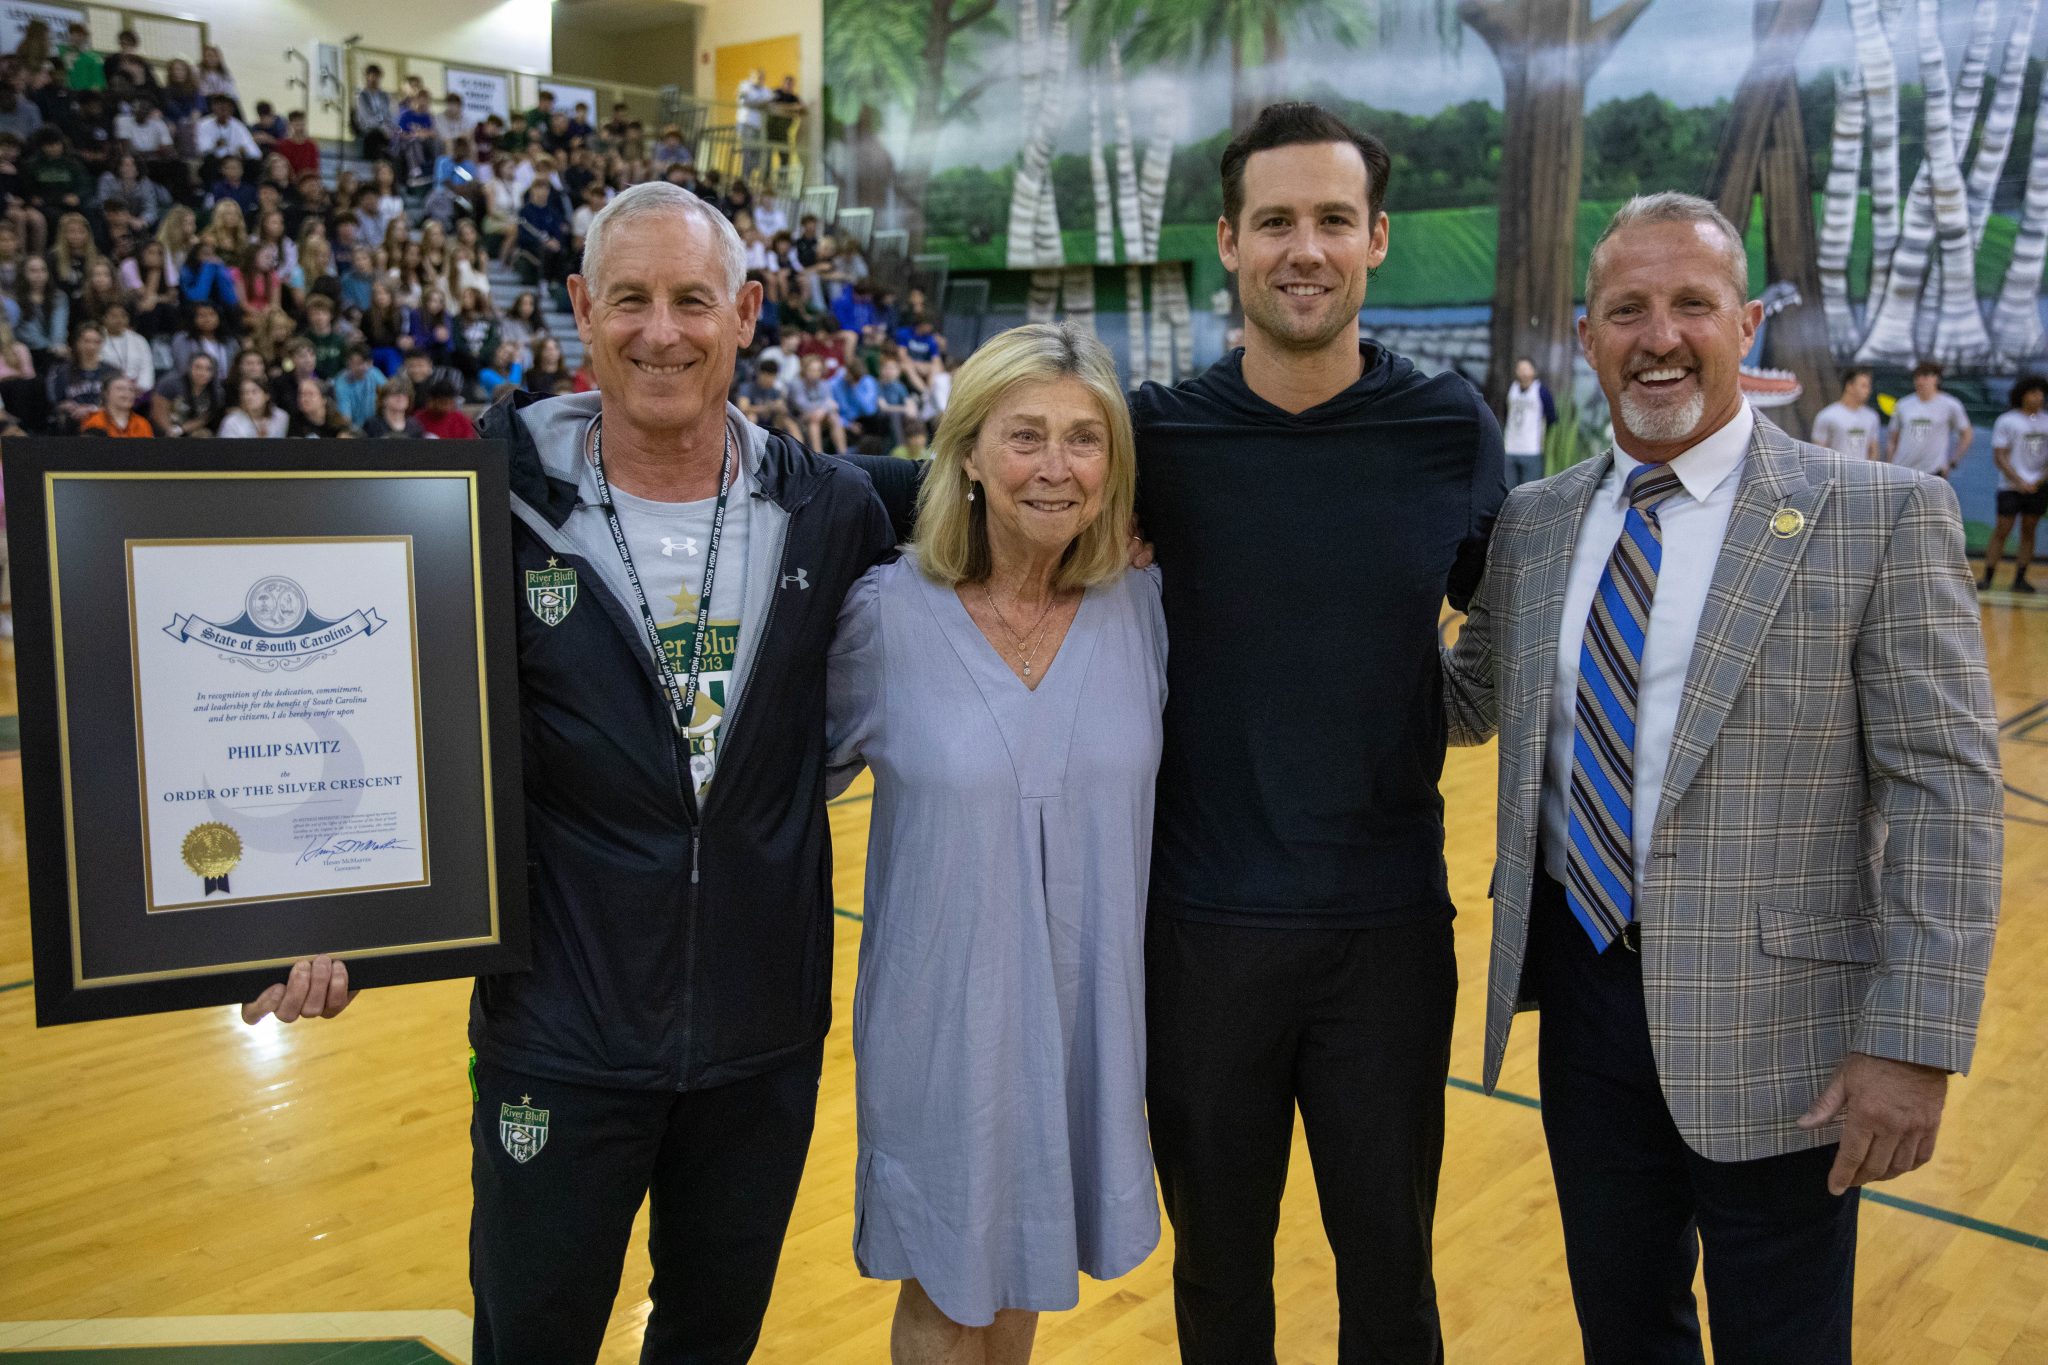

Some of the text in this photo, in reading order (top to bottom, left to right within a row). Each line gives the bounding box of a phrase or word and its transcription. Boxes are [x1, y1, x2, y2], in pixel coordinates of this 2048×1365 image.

[721, 472, 730, 497] SCHOOL
[609, 514, 646, 606] RIVER BLUFF HIGH SCHOOL
[703, 506, 724, 598] RIVER BLUFF HIGH SCHOOL
[529, 570, 574, 583] River Bluff
[200, 624, 353, 653] State of South Carolina
[644, 614, 661, 645] SCHOOL
[655, 645, 668, 665] HIGH
[685, 609, 708, 707] RIVER BLUFF HIGH SCHOOL
[662, 664, 677, 688] BLUFF
[193, 696, 368, 713] and leadership for the benefit of South Carolina
[196, 685, 364, 702] In recognition of the dedication, commitment,
[671, 687, 684, 711] RIVER
[208, 707, 355, 723] and her citizens, I do hereby confer upon
[228, 740, 341, 760] PHILIP SAVITZ
[280, 770, 291, 778] the
[163, 775, 402, 803] ORDER OF THE SILVER CRESCENT
[503, 1106, 524, 1119] River
[525, 1110, 547, 1122] Bluff
